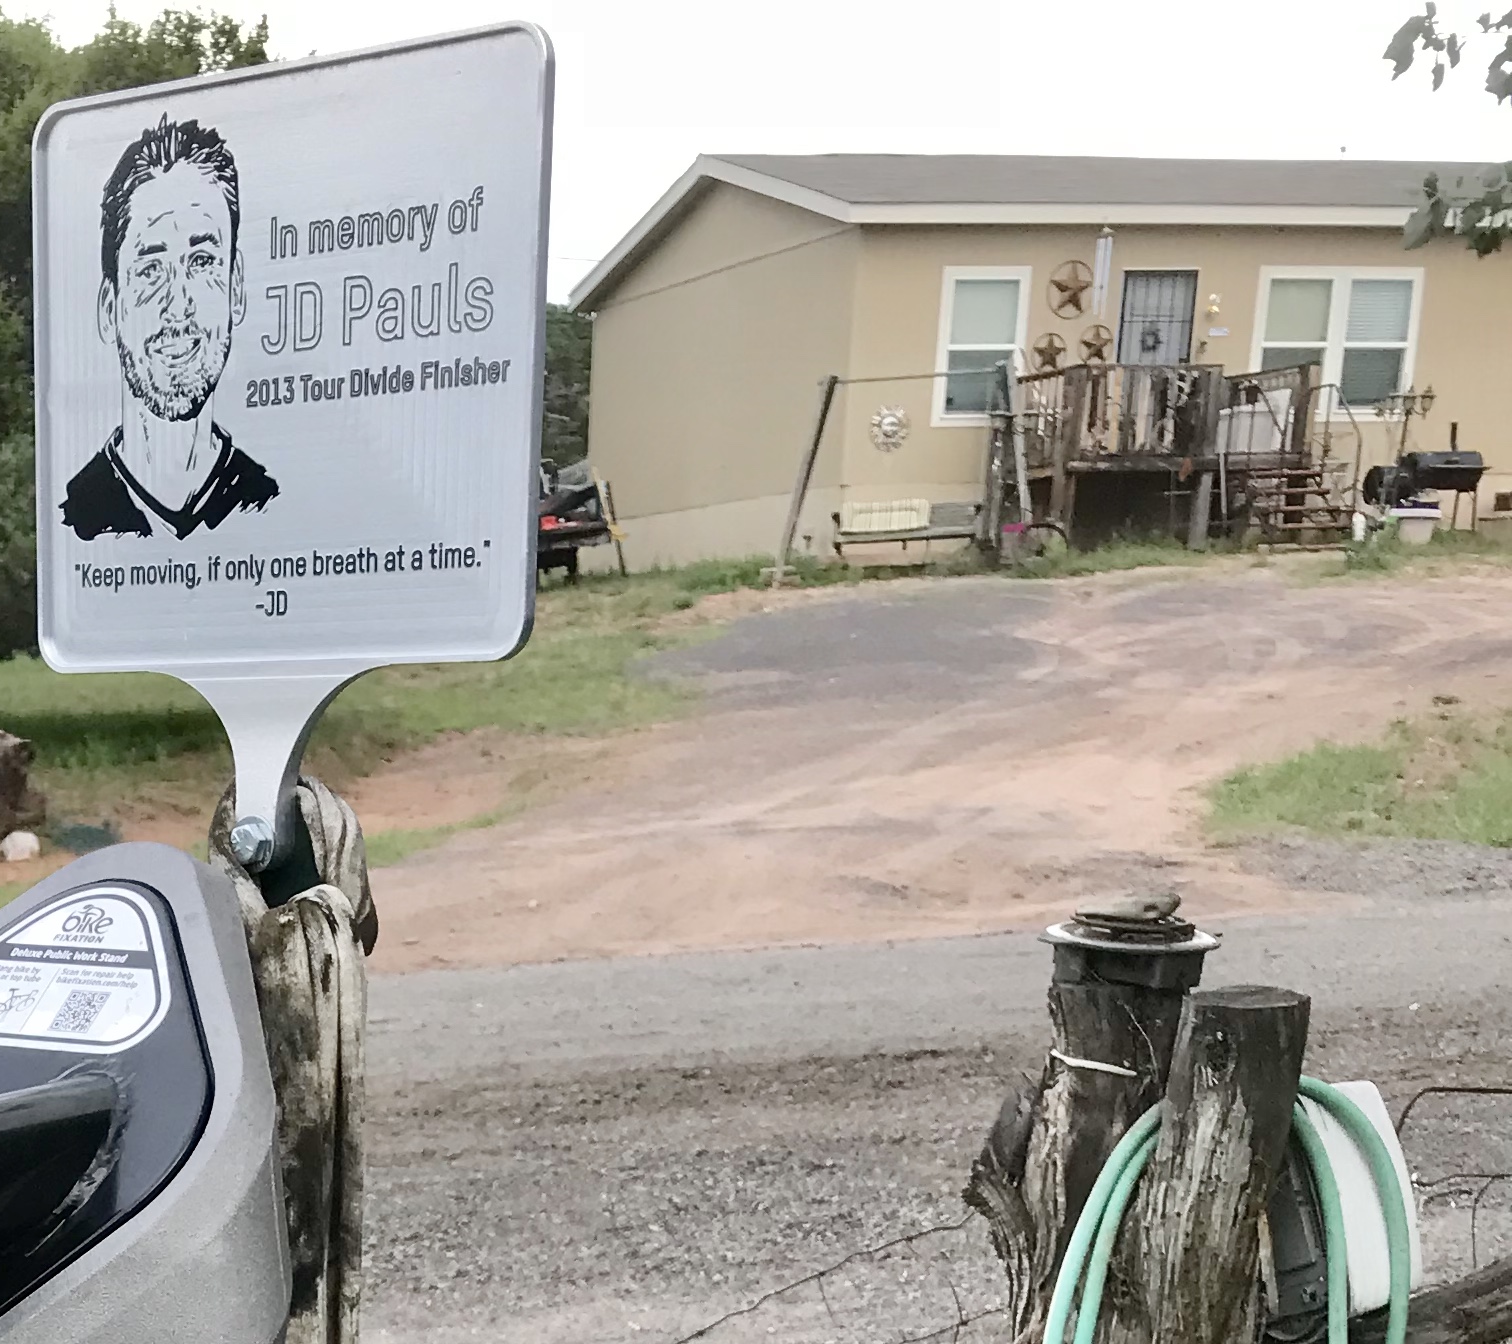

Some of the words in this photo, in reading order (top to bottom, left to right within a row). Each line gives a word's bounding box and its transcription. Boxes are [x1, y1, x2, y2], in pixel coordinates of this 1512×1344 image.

[270, 216, 298, 259] In
[308, 205, 437, 255] memory
[447, 186, 484, 233] of
[260, 280, 322, 355] JD
[343, 262, 494, 346] Pauls
[245, 377, 296, 407] 2013
[299, 373, 346, 403] Tour
[350, 365, 414, 399] Divide
[420, 356, 511, 393] Finisher
[74, 562, 125, 592] "Keep
[130, 558, 202, 589] moving,
[207, 555, 221, 582] if
[225, 553, 265, 585] only
[270, 554, 308, 578] one
[312, 547, 379, 575] breath
[383, 546, 405, 571] at
[410, 551, 424, 569] a
[428, 540, 491, 570] time."
[255, 590, 288, 616] -JD
[53, 934, 104, 943] FIXATION
[10, 947, 43, 958] Deluxe
[43, 949, 72, 960] Public
[73, 951, 97, 962] Work
[98, 953, 128, 963] Stand
[15, 965, 30, 973] bike
[31, 967, 41, 975] by
[61, 968, 81, 976] Scan
[82, 969, 92, 977] for
[94, 970, 116, 979] repair
[117, 971, 134, 980] help
